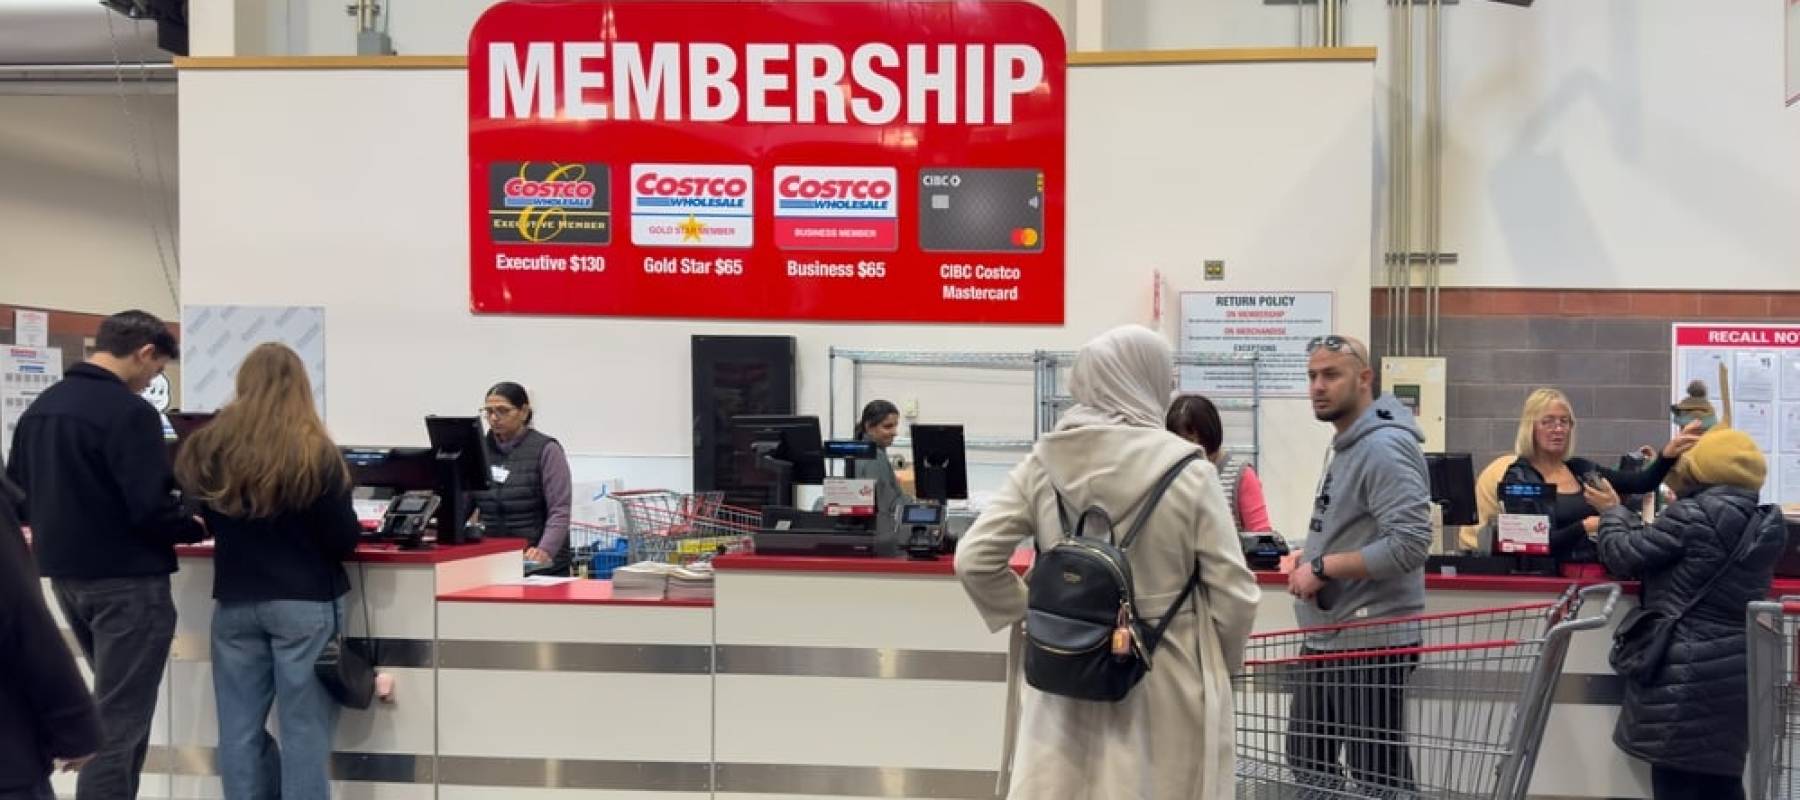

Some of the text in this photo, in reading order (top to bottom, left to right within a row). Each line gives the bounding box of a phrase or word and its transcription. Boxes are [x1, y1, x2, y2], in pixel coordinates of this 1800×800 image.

[488, 42, 1044, 125] MEMBERSHIP
[505, 178, 594, 198] COSTCO
[636, 173, 747, 197] COSTCO
[780, 175, 891, 199] COSTCO
[923, 175, 949, 186] CIBC
[670, 198, 744, 207] WHOLESALE
[815, 200, 888, 210] WHOLESALE
[649, 225, 673, 234] GOLD
[496, 254, 605, 272] Executive $130
[644, 257, 743, 276] Gold Star $65
[787, 260, 886, 278] Business $65
[940, 264, 1021, 280] CIBC Costco
[942, 285, 1018, 300] Mastercard
[1215, 296, 1295, 307] RETURN POLICY
[1709, 330, 1800, 344] RECALL NO
